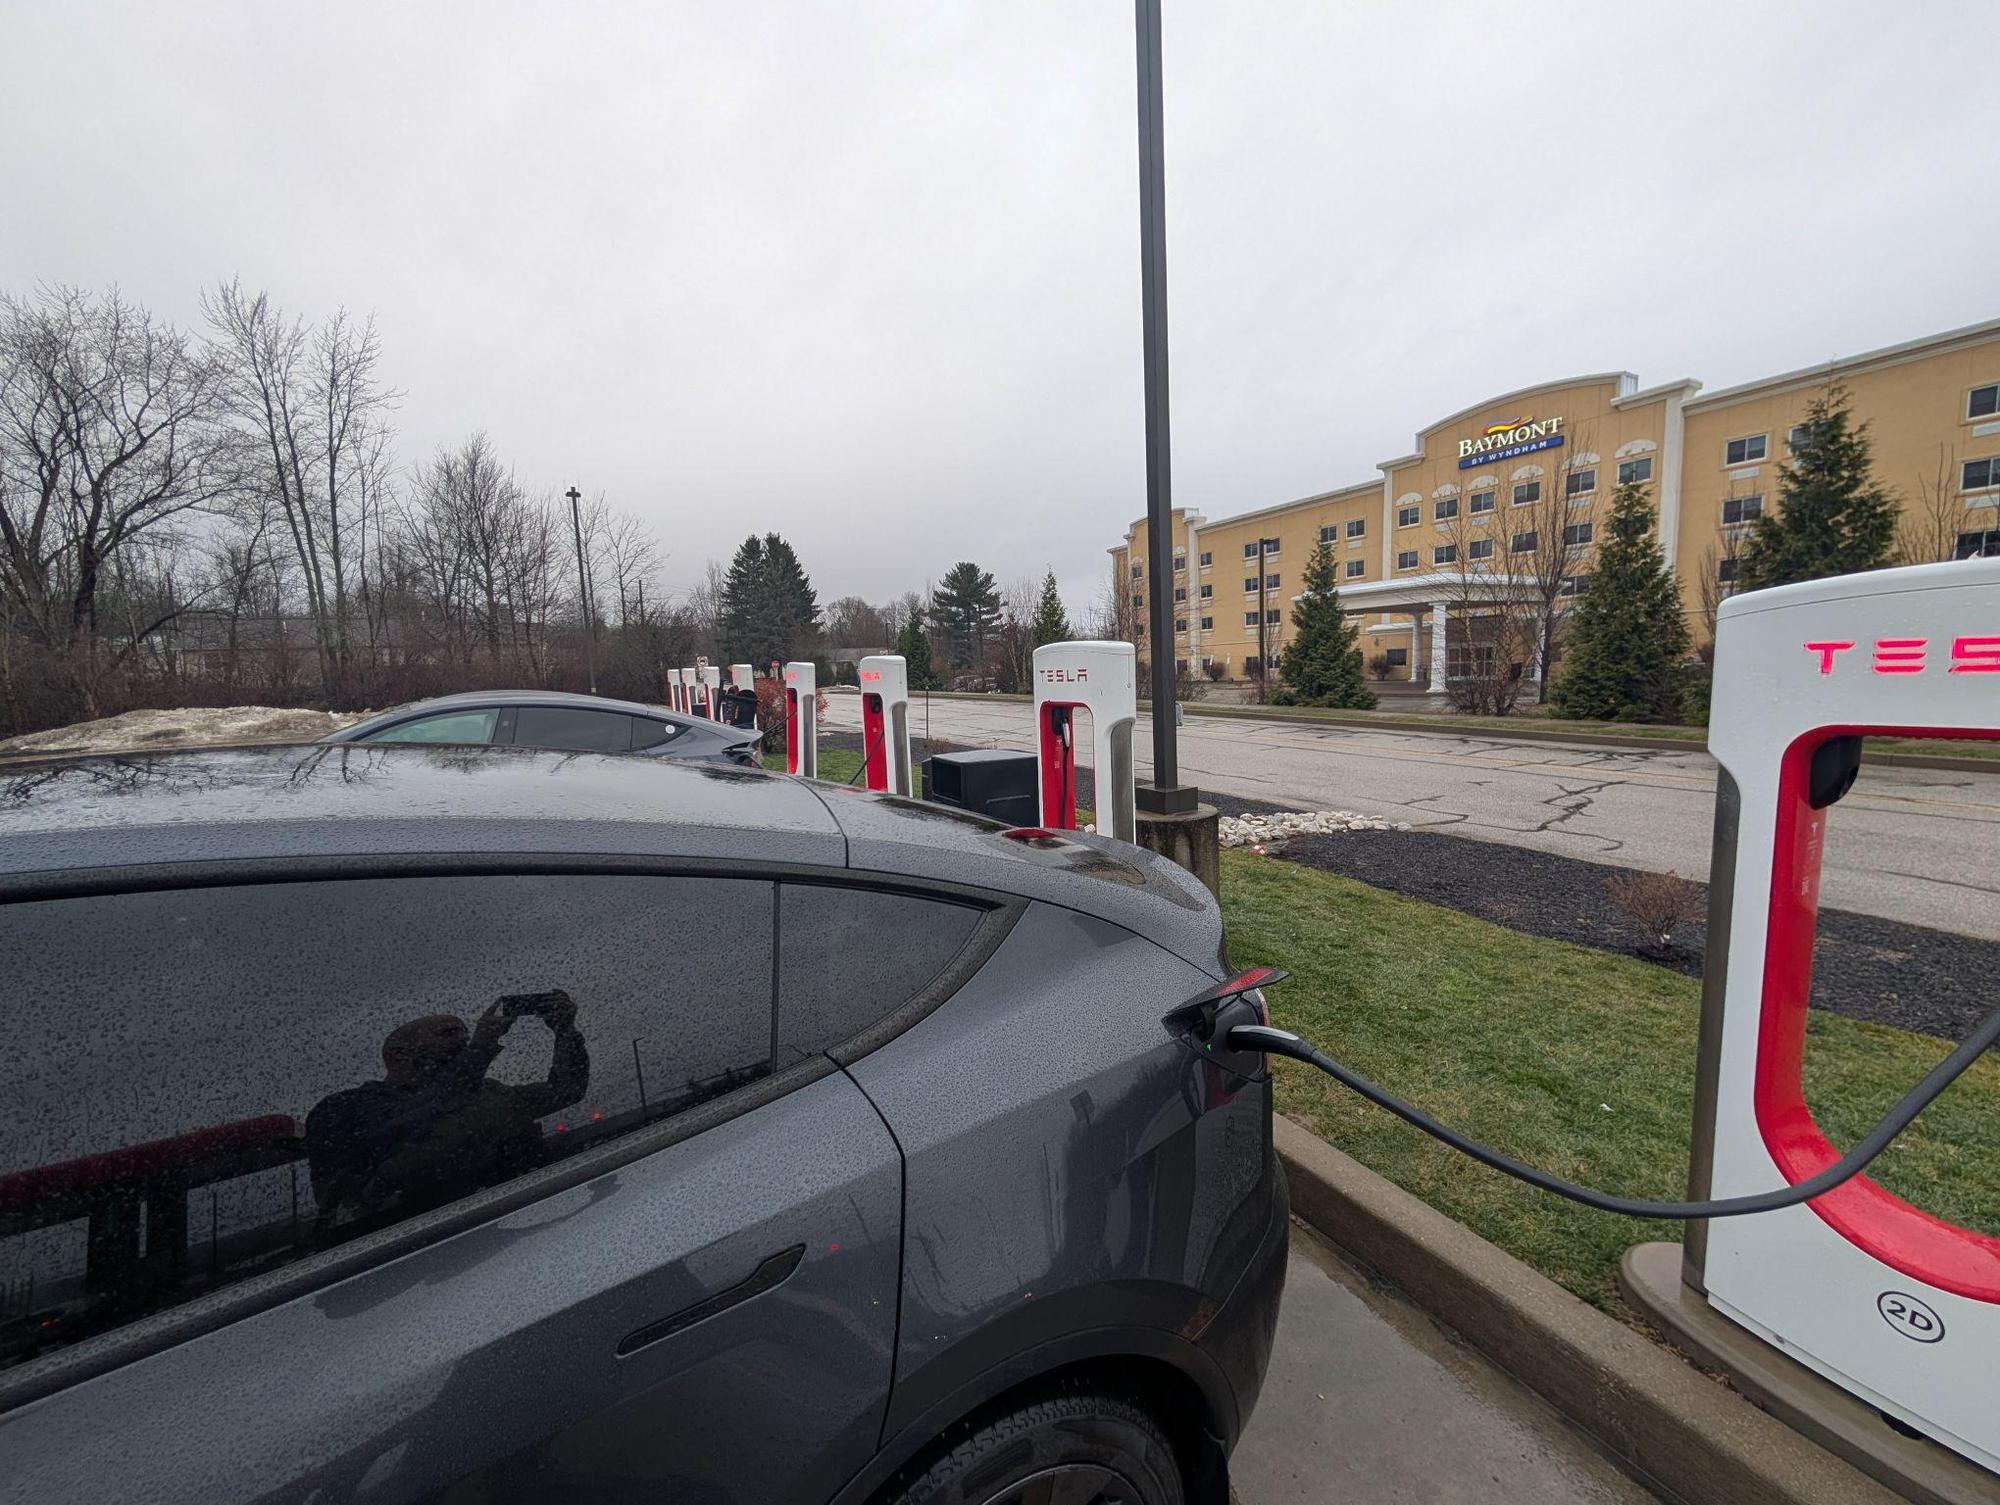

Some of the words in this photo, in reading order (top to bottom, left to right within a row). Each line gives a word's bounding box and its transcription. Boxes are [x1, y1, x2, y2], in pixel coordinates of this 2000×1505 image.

[1459, 417, 1562, 457] BAYMONT
[1471, 456, 1486, 465] BY
[1488, 441, 1547, 461] WYNDHAM
[1040, 669, 1088, 682] TESLA
[1886, 1300, 1933, 1331] 2D
